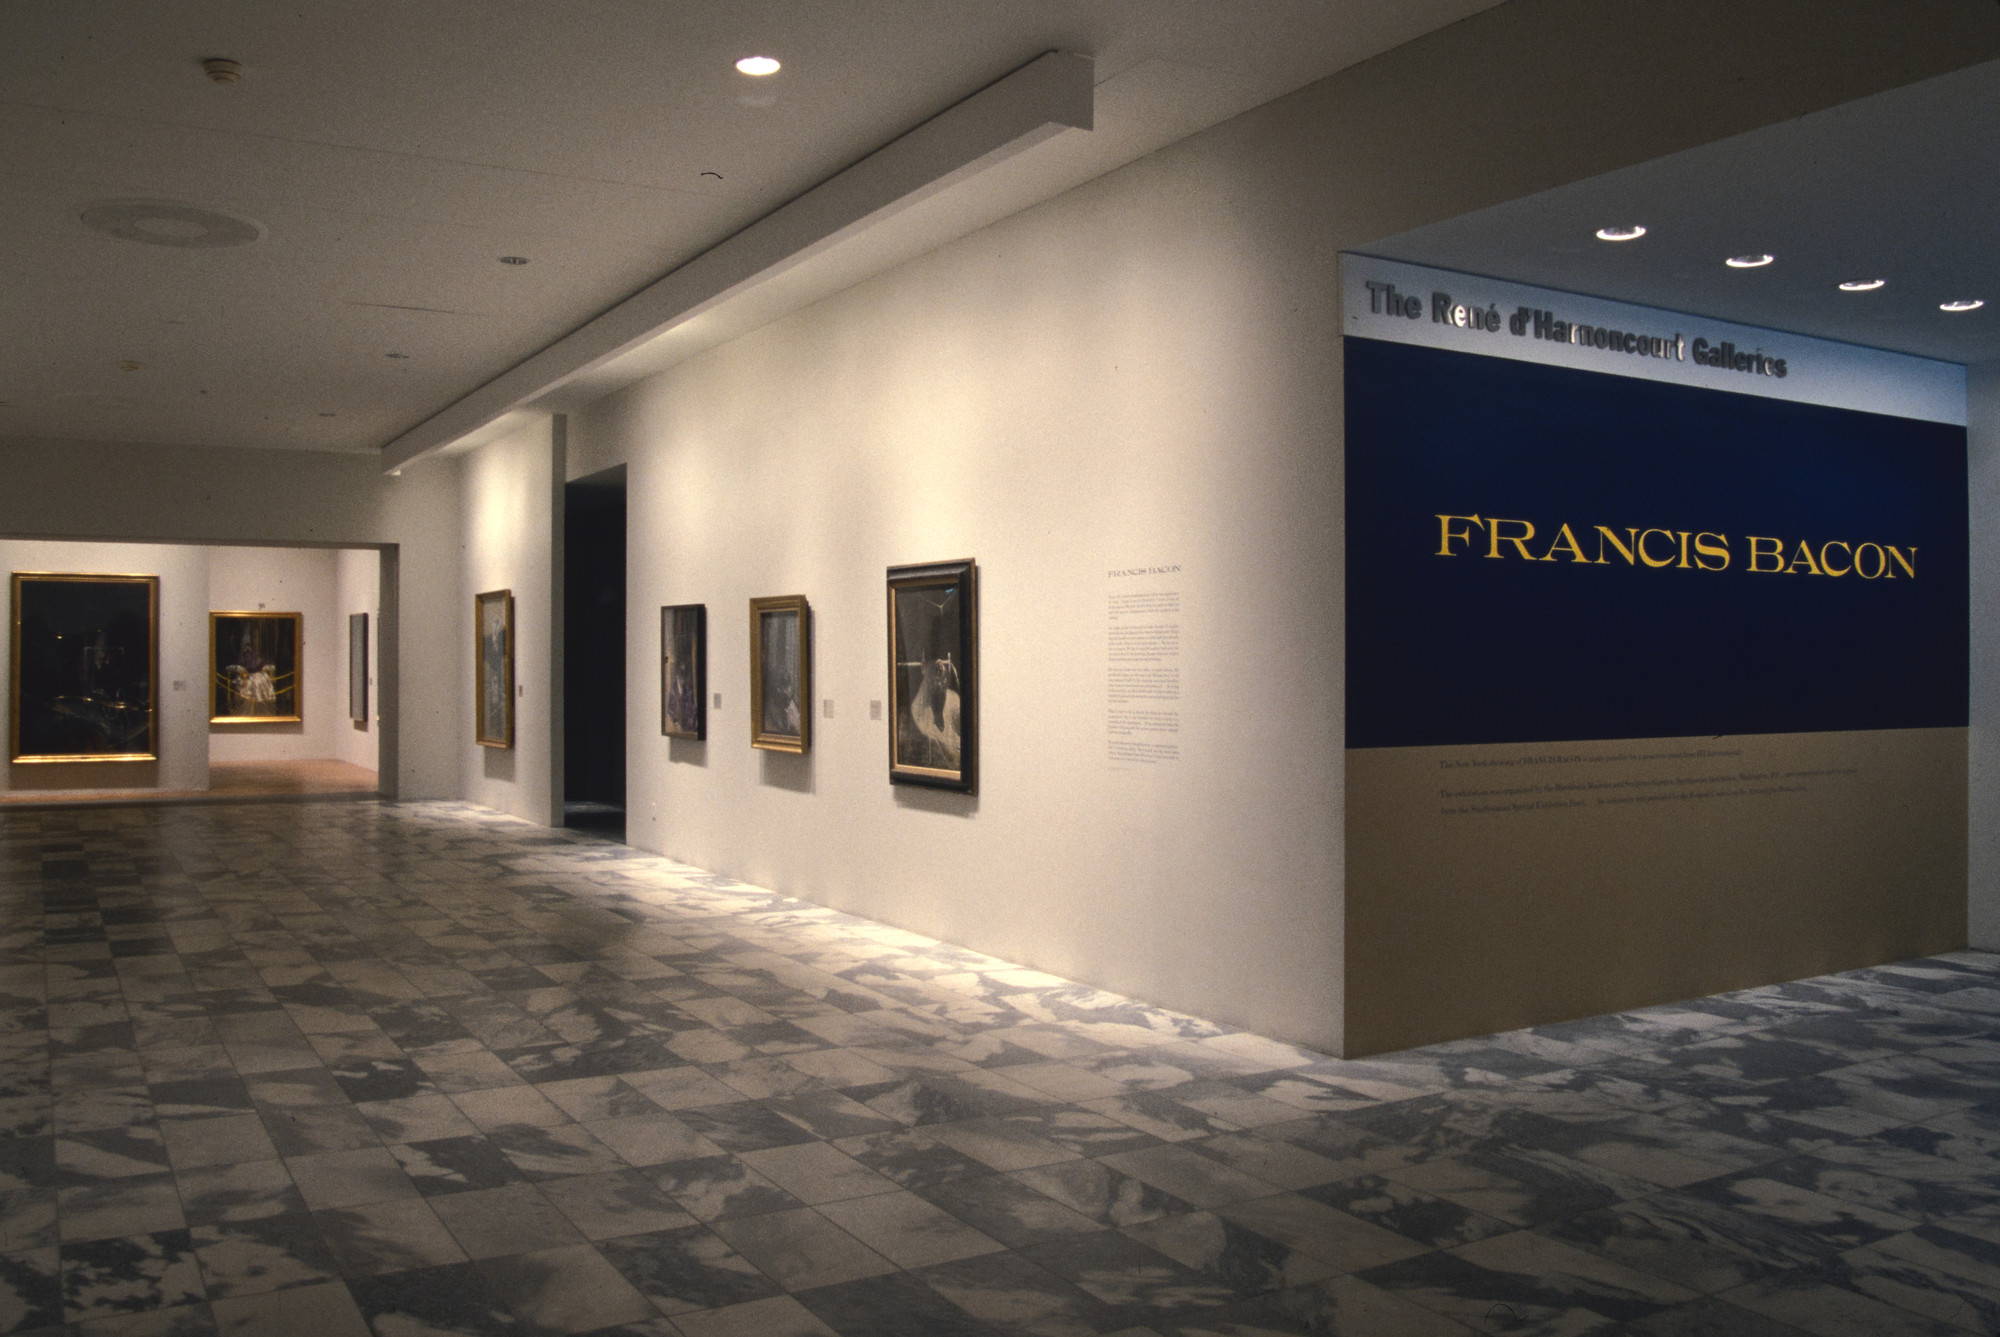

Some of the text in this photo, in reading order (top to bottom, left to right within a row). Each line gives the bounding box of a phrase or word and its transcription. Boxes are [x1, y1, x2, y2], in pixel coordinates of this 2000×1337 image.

[1365, 280, 1788, 378] The René d'Harnoncourt Galleries
[1435, 513, 1918, 579] FRANCIS BACON
